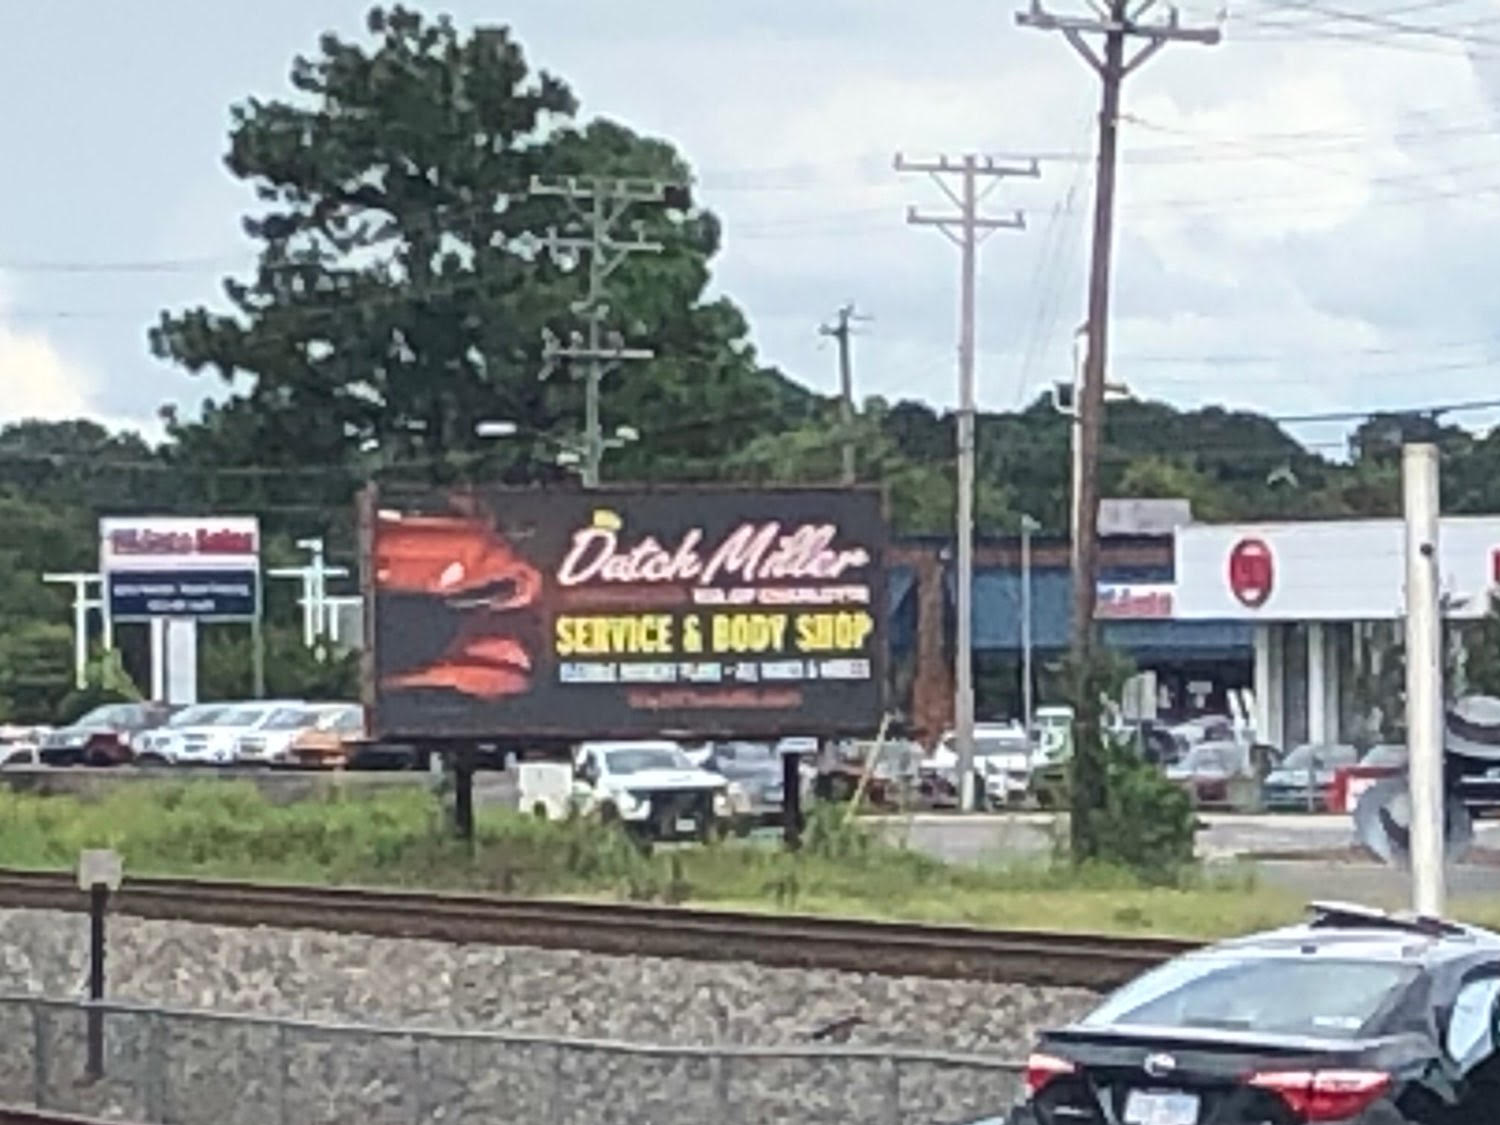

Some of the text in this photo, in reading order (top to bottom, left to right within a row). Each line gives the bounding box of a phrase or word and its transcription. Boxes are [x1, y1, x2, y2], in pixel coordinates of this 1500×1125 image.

[700, 520, 870, 586] Miller
[556, 610, 874, 655] SERVICE & BODY SHOP
